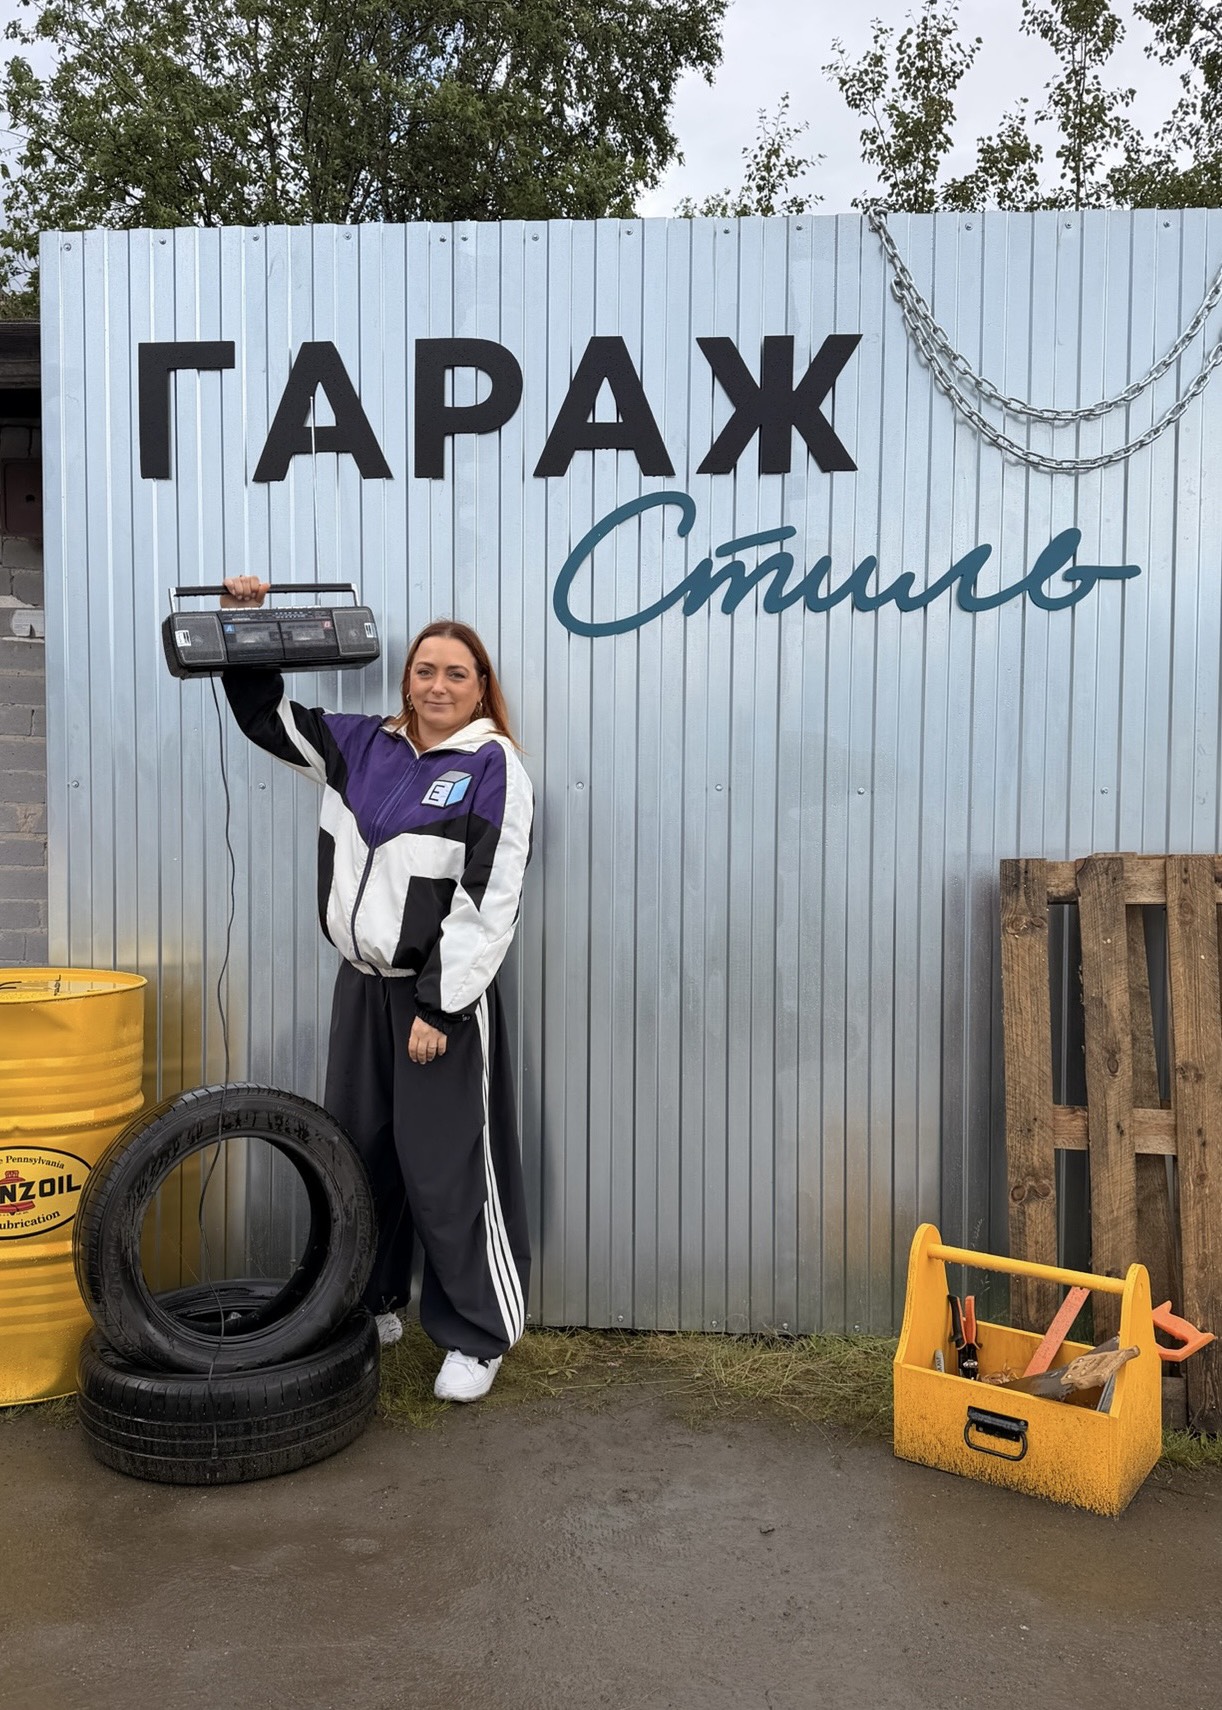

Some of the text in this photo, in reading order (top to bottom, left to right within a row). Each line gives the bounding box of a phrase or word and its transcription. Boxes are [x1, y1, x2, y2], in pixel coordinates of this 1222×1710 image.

[138, 334, 863, 482] ГАРАЖ
[553, 491, 1141, 637] Стиль
[428, 784, 446, 802] E
[6, 1155, 65, 1169] Pennsylvania
